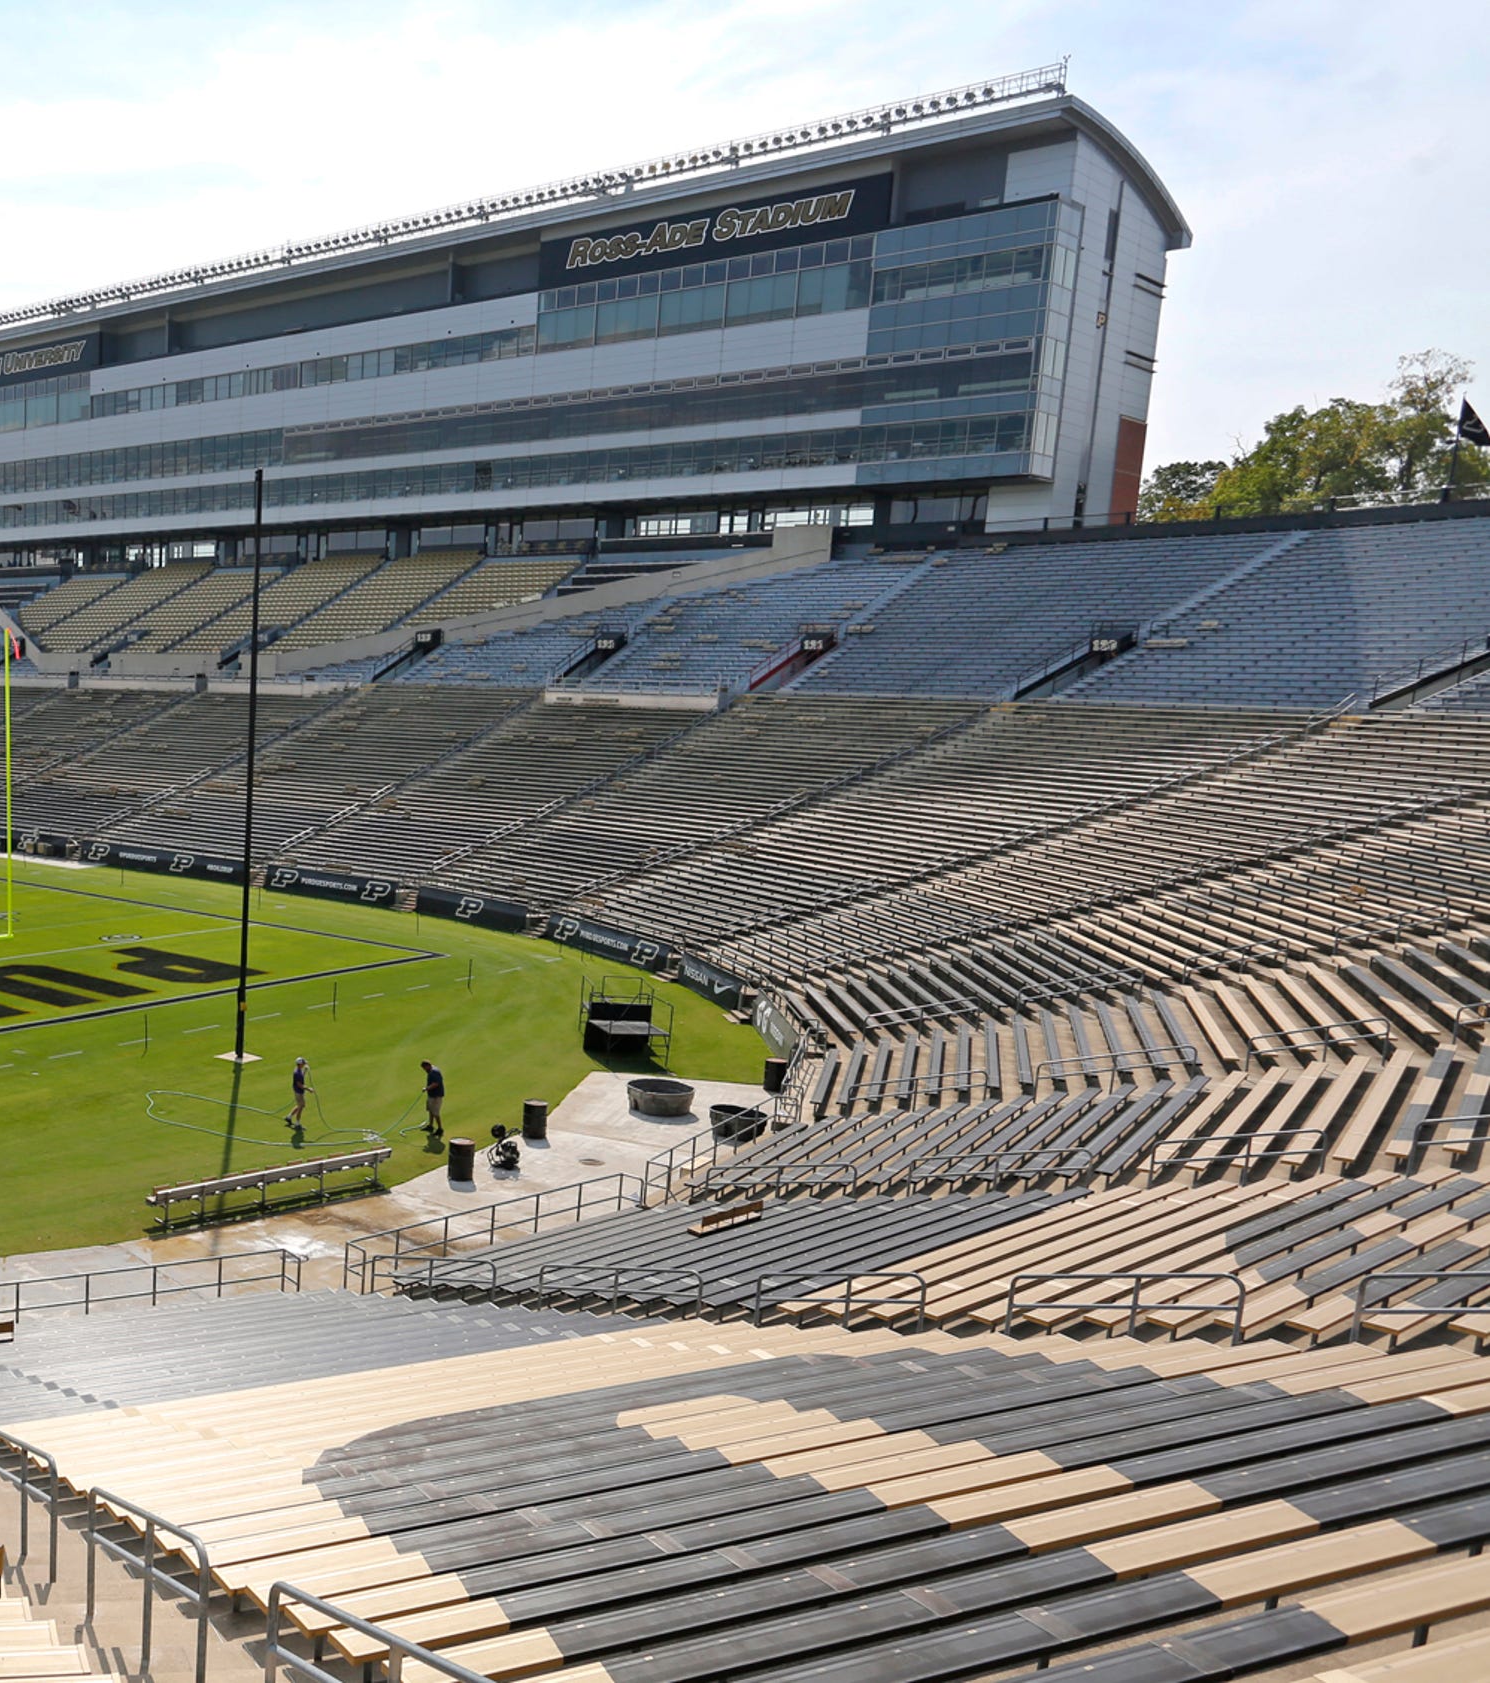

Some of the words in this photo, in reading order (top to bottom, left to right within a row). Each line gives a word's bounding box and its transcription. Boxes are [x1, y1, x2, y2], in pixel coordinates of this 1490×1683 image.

[566, 217, 710, 270] ROSS-ADE
[712, 189, 856, 242] STADIUM
[3, 340, 87, 375] UNIVERSITY
[88, 843, 110, 860] P
[169, 854, 194, 872] P
[271, 868, 299, 888] P
[361, 881, 391, 901] P
[456, 897, 484, 918] P
[554, 917, 579, 941] P
[630, 940, 660, 965] P
[683, 965, 709, 986] NISSAN
